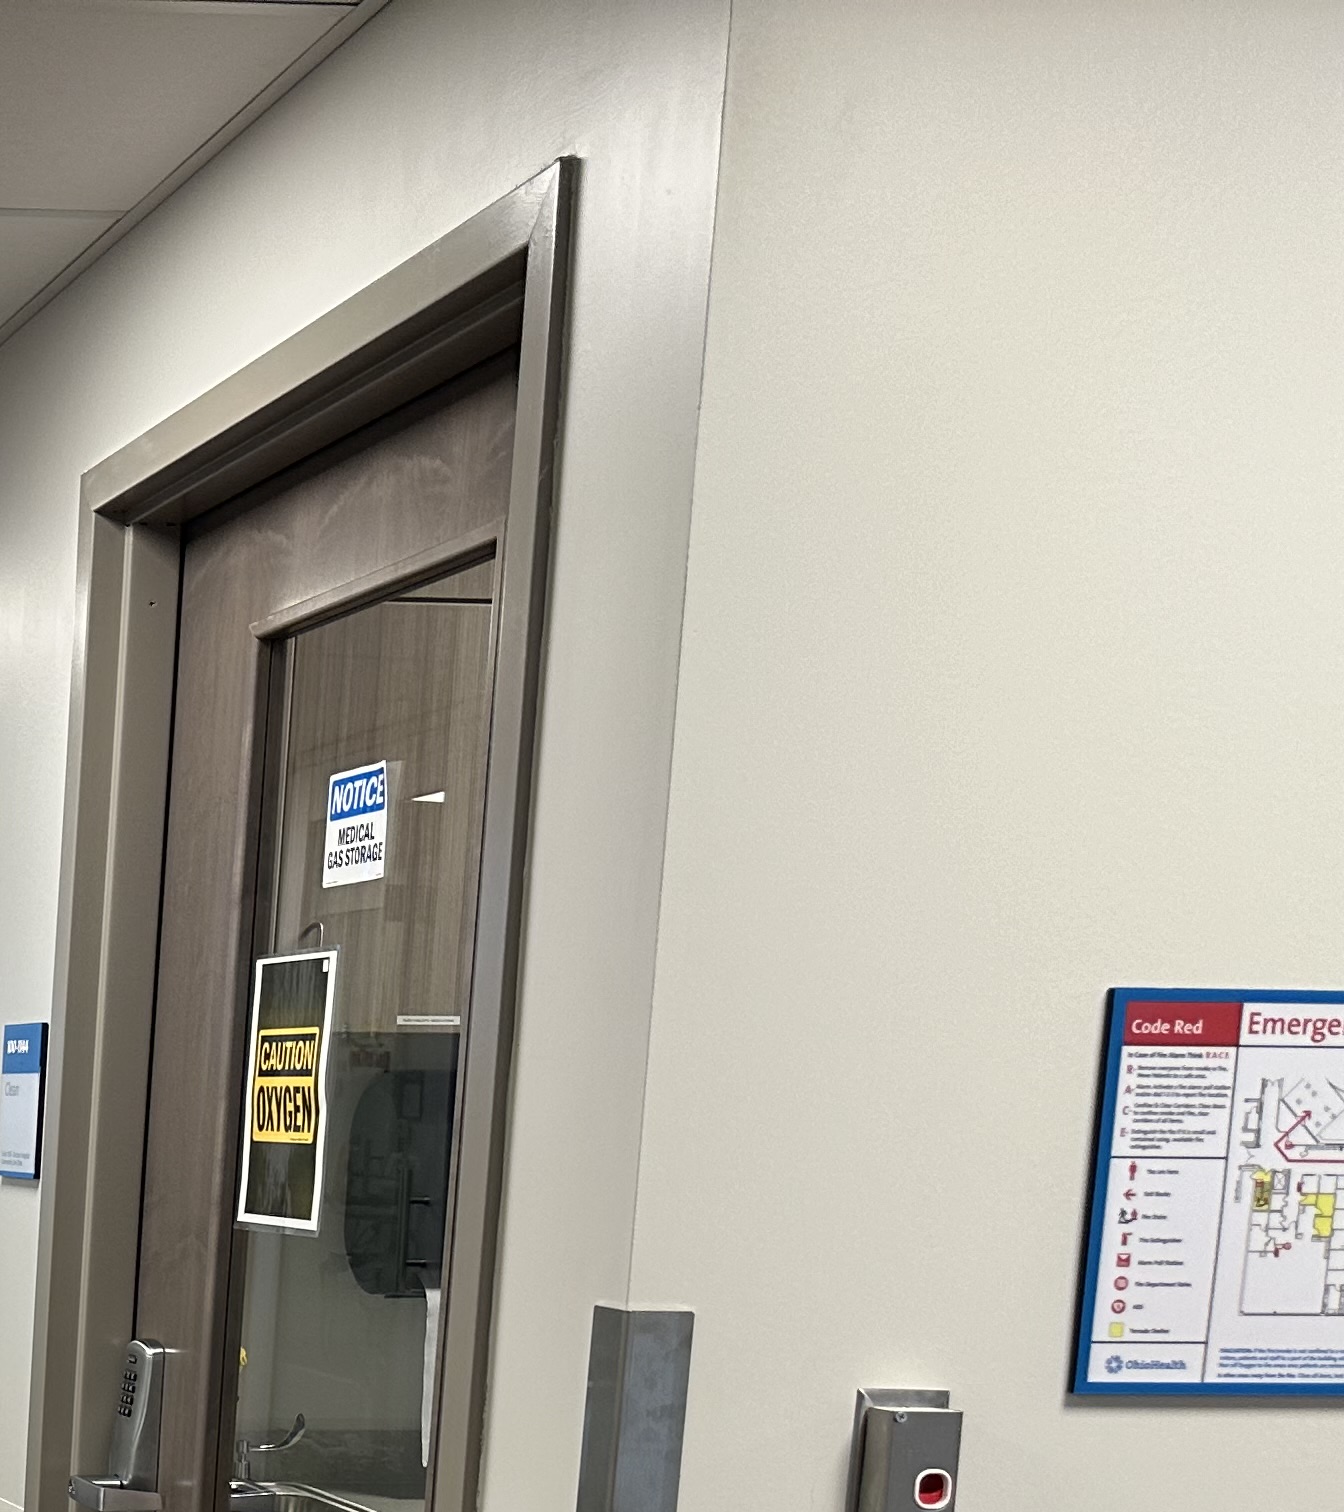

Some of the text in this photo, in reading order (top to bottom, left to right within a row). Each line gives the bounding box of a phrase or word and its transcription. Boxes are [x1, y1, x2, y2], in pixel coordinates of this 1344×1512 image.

[332, 773, 384, 815] NOTICE
[338, 822, 375, 846] MEDICAL
[327, 842, 383, 870] GAS STORAGE
[1131, 1019, 1203, 1035] Code Red
[1248, 1011, 1344, 1044] Emerge
[260, 1040, 315, 1071] CAUTION
[257, 1085, 312, 1133] OXYGEN
